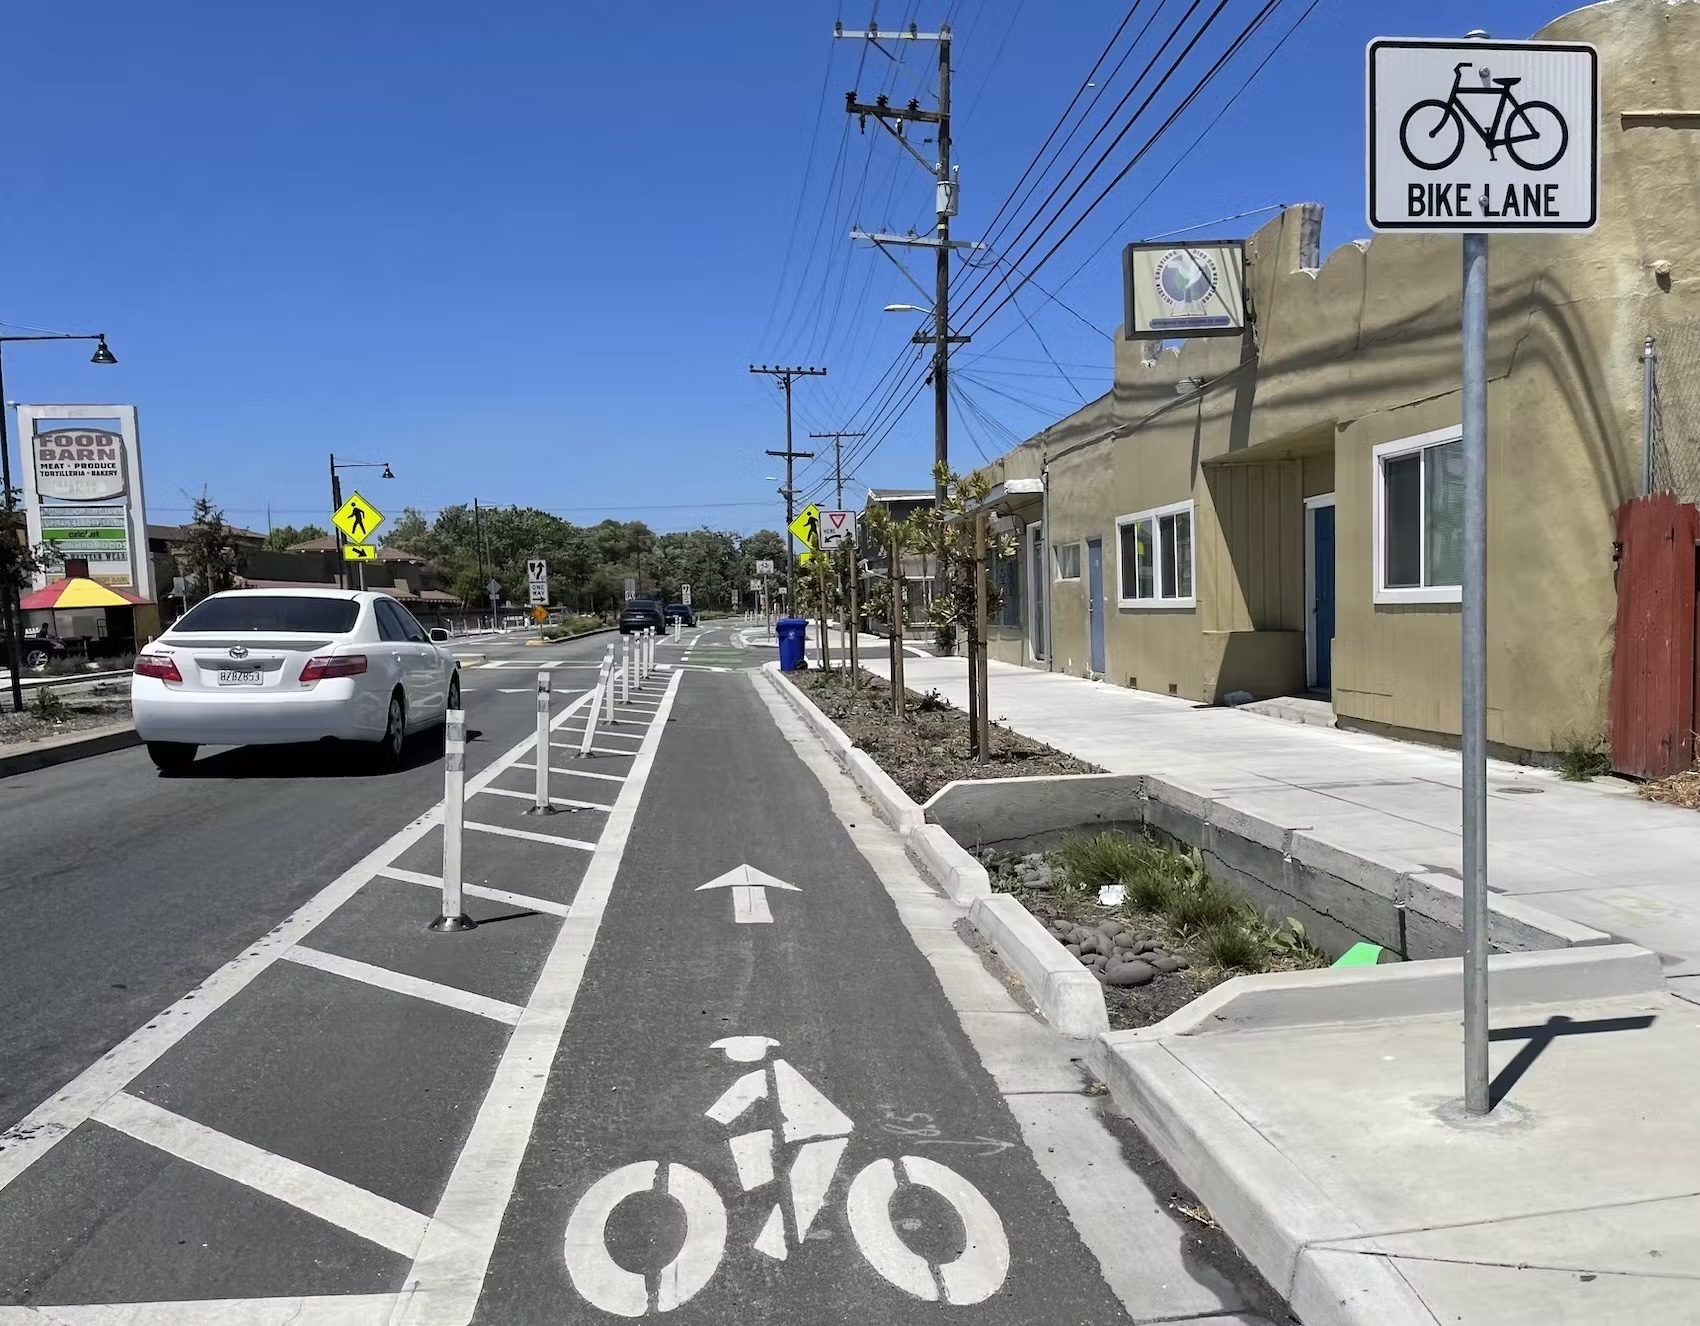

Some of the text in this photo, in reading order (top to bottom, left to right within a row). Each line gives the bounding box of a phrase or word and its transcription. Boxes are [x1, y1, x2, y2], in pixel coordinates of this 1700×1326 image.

[1408, 184, 1560, 217] BIKE LANE
[39, 434, 113, 447] FOOD
[39, 448, 116, 461] BARN
